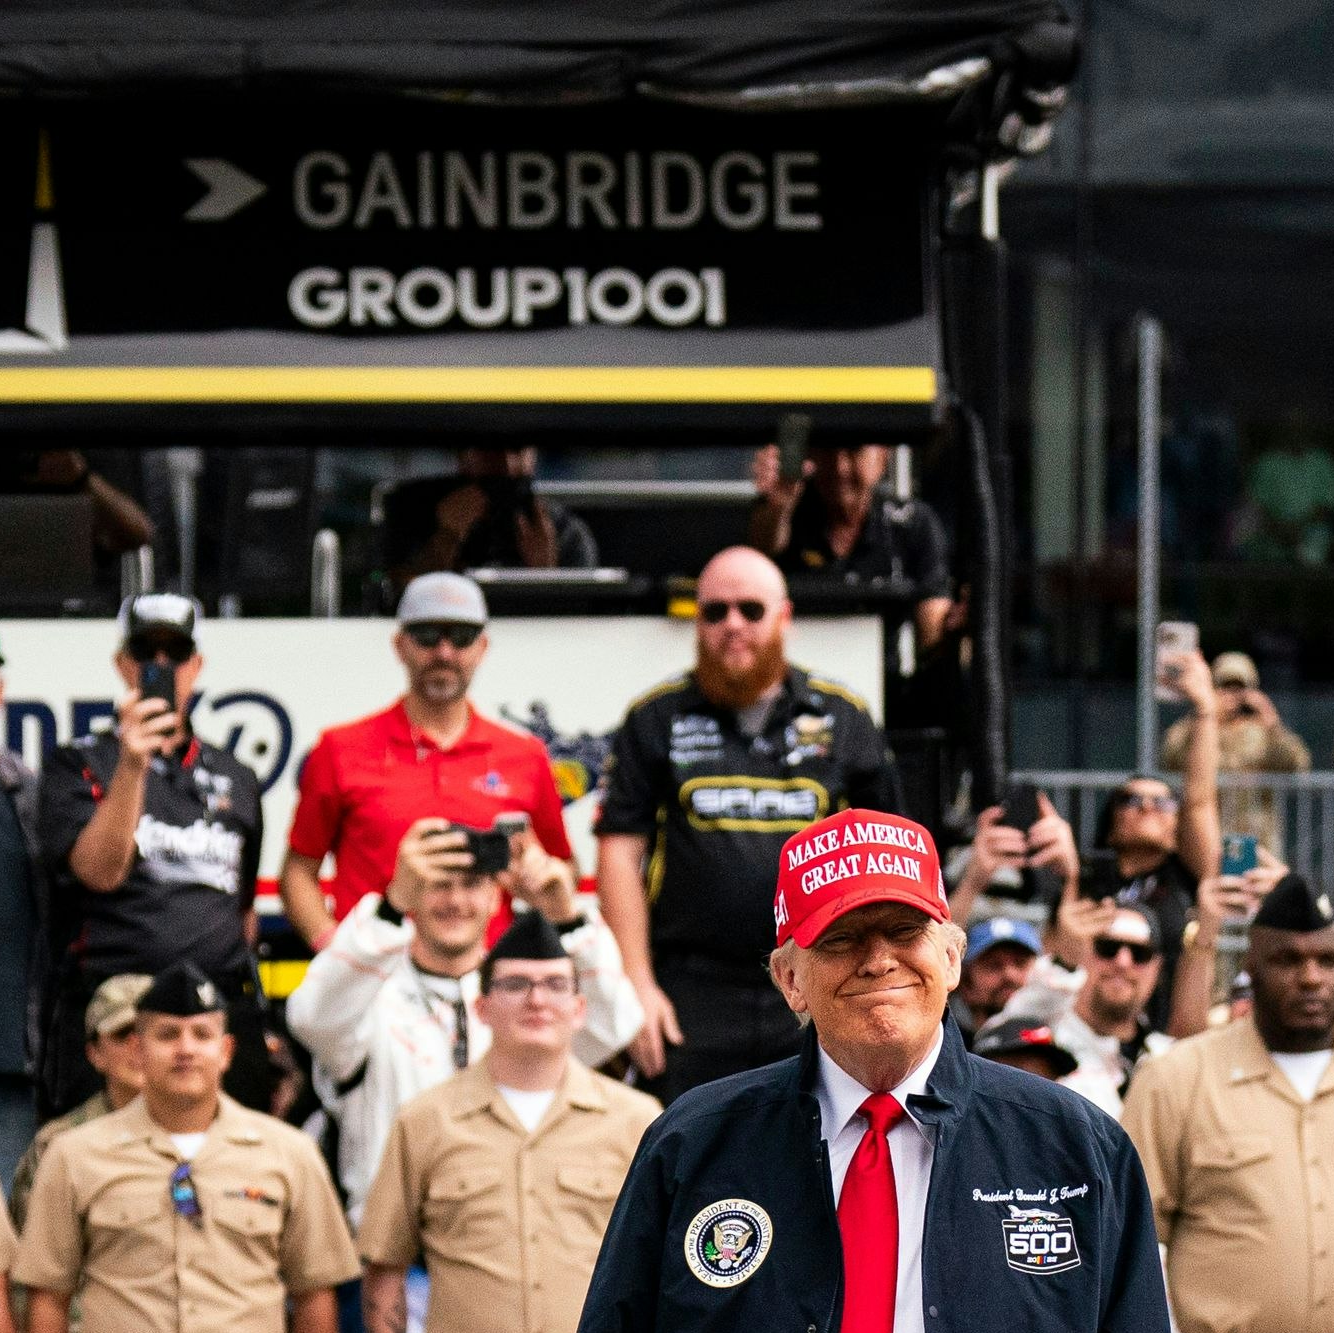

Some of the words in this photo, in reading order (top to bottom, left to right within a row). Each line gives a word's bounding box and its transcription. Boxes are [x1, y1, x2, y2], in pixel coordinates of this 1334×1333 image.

[292, 150, 823, 230] GAINBRIDGE
[787, 829, 840, 871] MAKE
[842, 822, 929, 855] AMERICA
[801, 853, 861, 895] GREAT
[865, 852, 921, 883] AGAIN
[972, 1188, 1014, 1202] President
[1016, 1188, 1047, 1201] Donald
[1060, 1183, 1089, 1200] Trump
[690, 1202, 739, 1236] PRESIDENT
[1018, 1223, 1056, 1232] DAYTONA
[758, 1216, 770, 1253] UNITED
[1009, 1232, 1072, 1255] 500
[693, 1261, 714, 1282] SEAL
[729, 1257, 761, 1284] STATES
